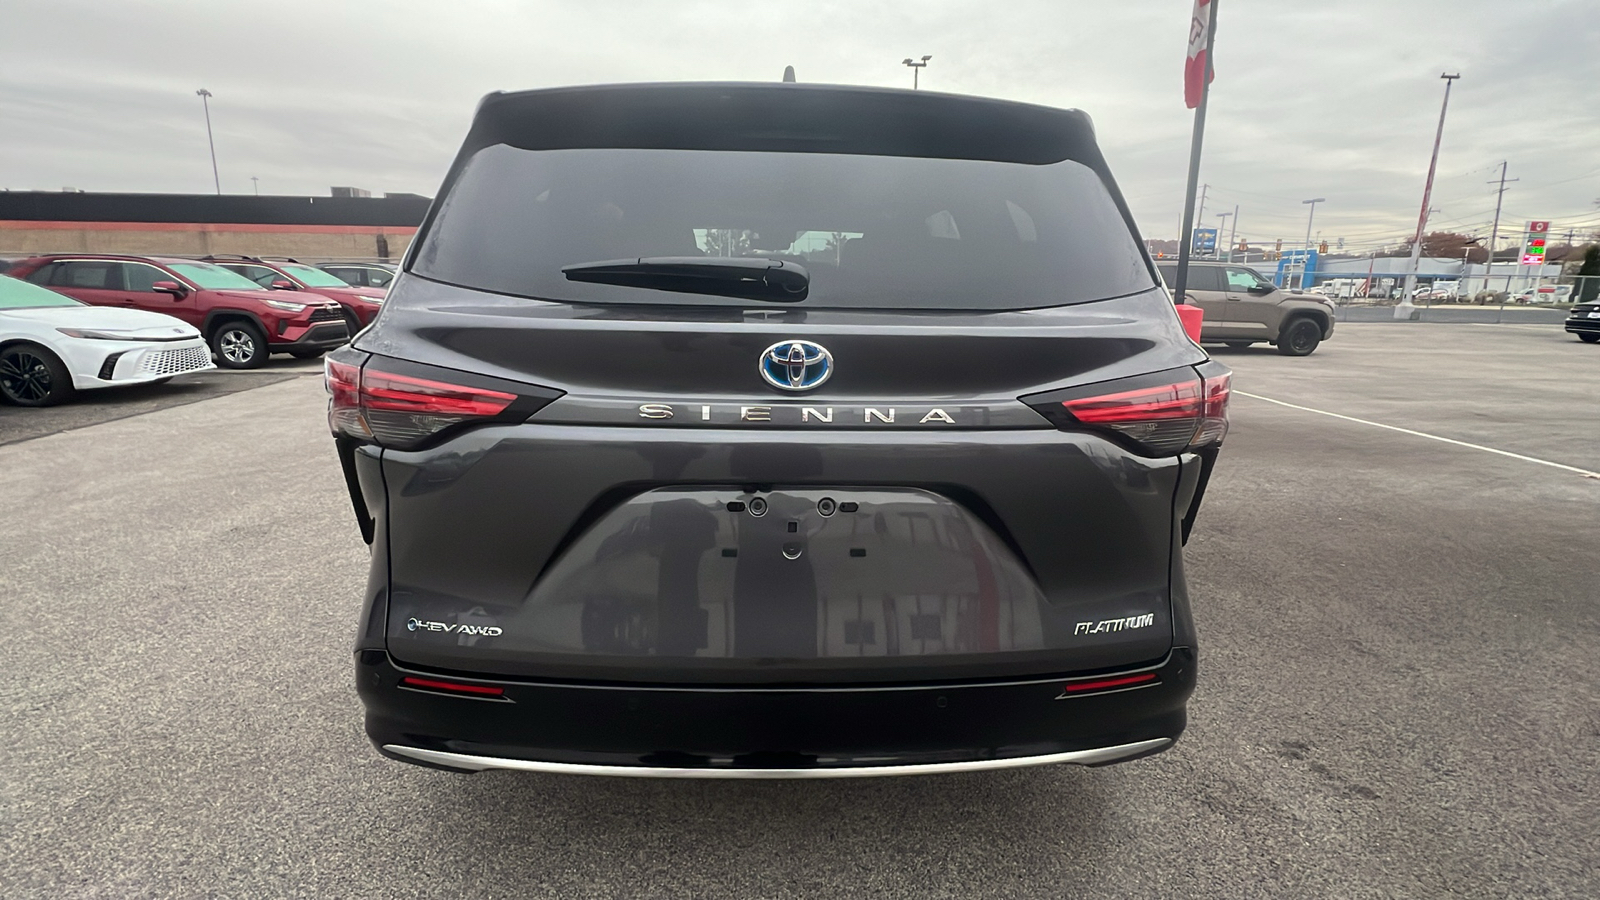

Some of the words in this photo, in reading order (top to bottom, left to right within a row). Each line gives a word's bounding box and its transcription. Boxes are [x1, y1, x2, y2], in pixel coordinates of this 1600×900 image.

[638, 403, 956, 425] SIENNA
[457, 624, 503, 637] AWD
[1073, 612, 1154, 636] PLATINUM
